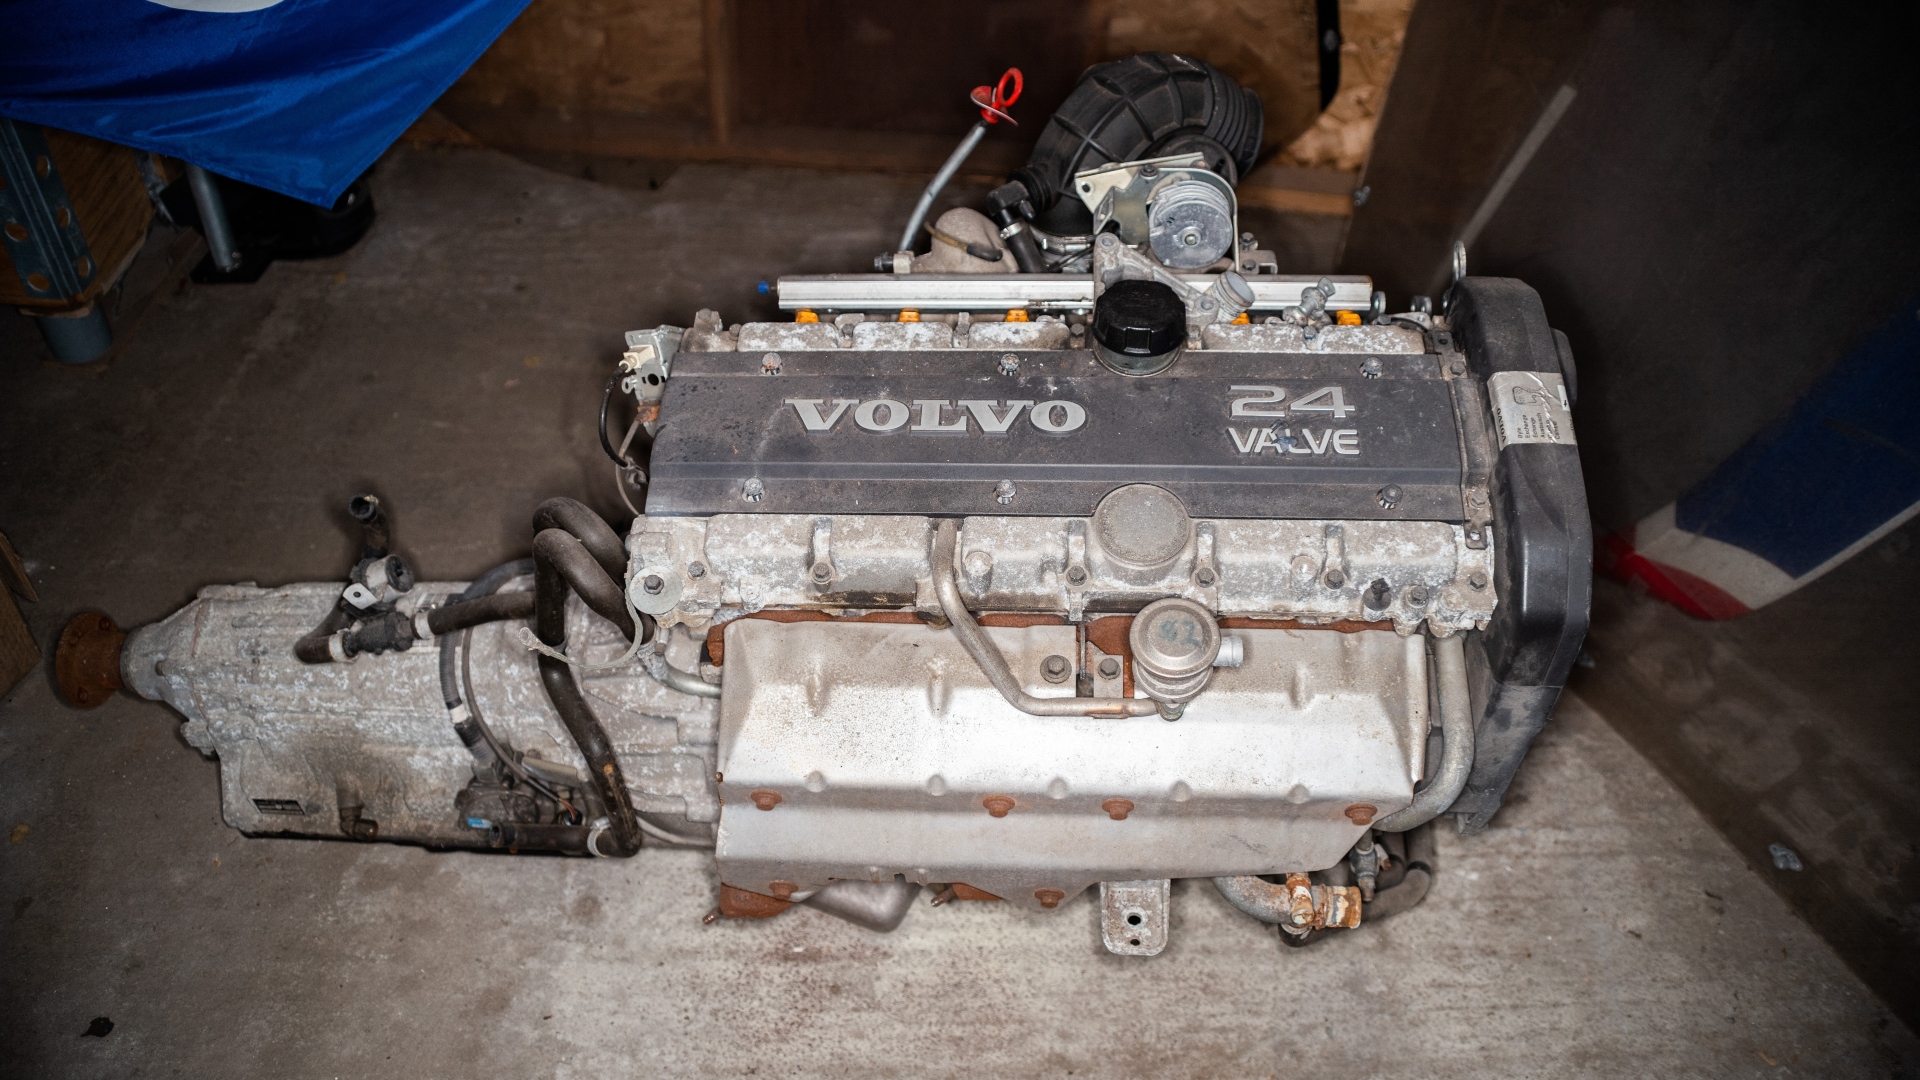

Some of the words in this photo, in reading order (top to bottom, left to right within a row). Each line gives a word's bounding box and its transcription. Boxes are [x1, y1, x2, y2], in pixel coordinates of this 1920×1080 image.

[783, 399, 1087, 435] VOLVO
[1228, 384, 1356, 419] 24
[1227, 427, 1361, 455] VALVE
[1496, 407, 1507, 443] VOLVO
